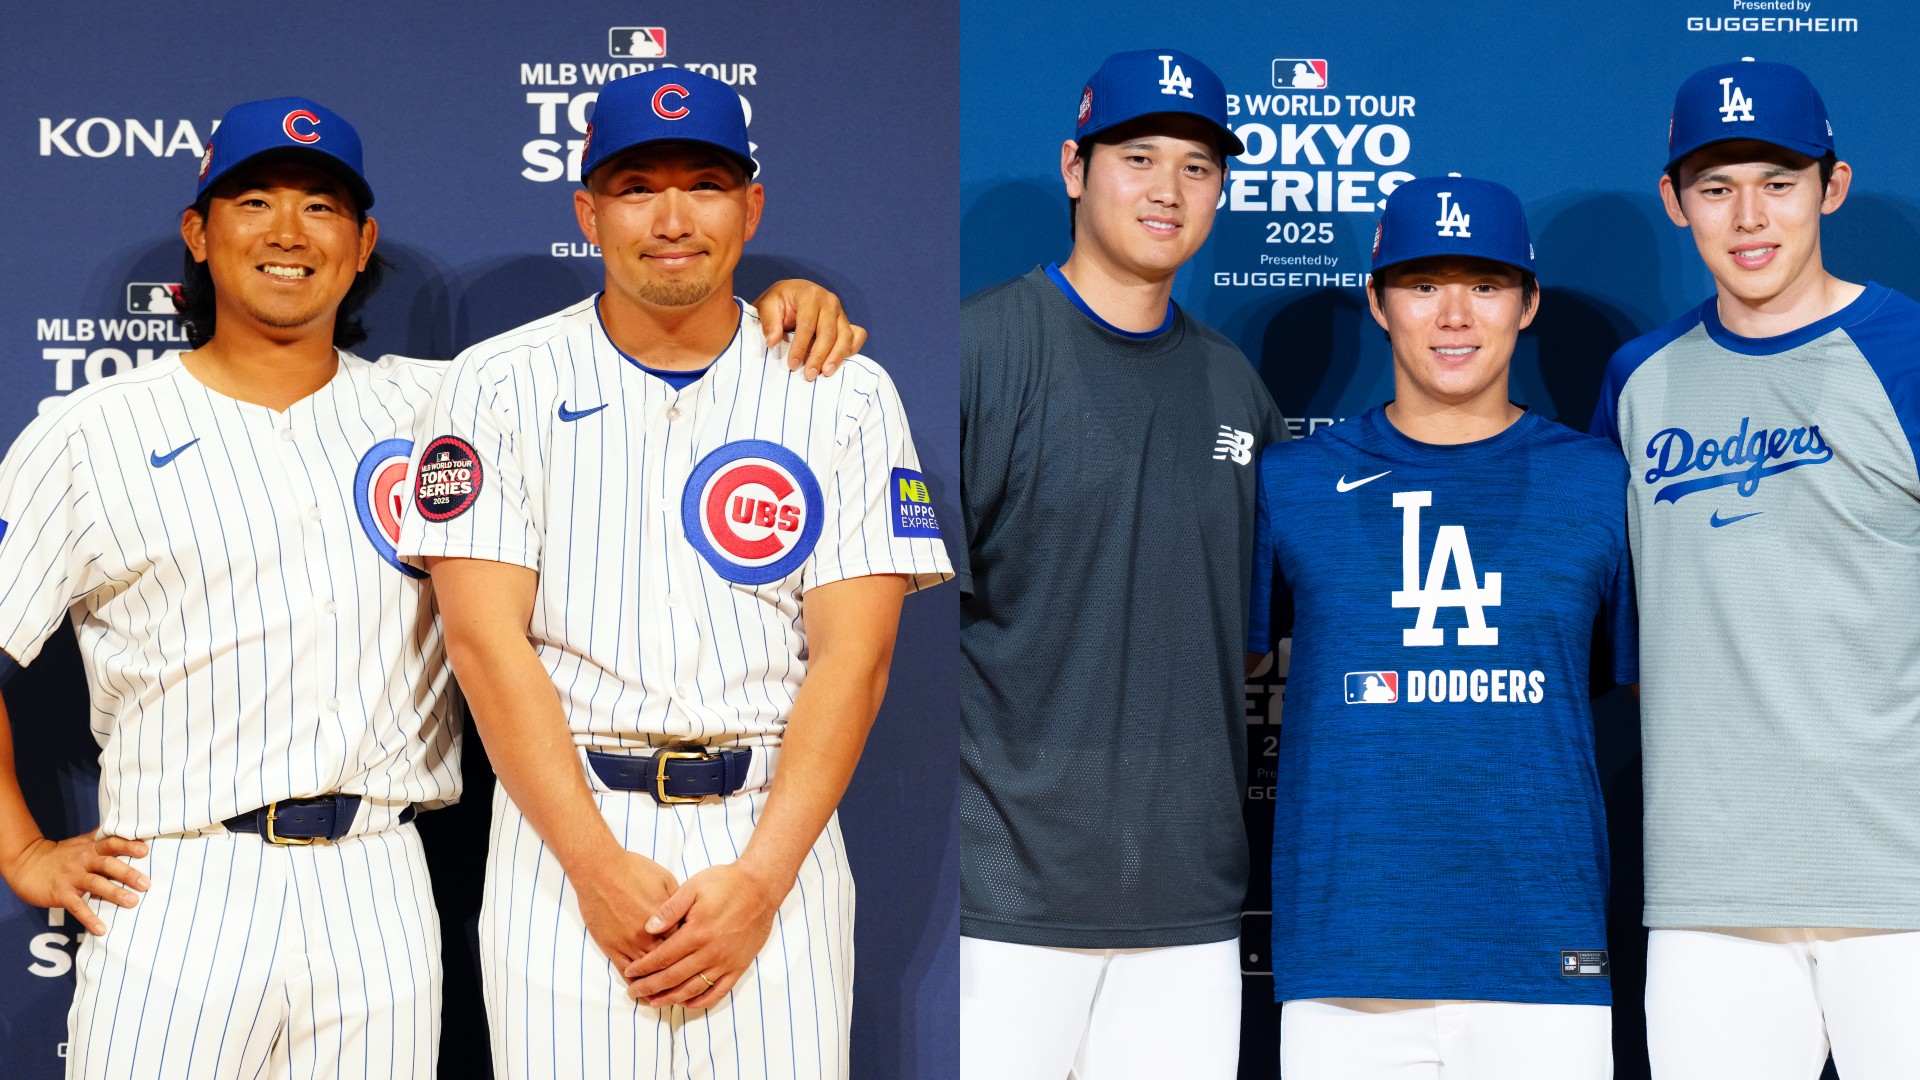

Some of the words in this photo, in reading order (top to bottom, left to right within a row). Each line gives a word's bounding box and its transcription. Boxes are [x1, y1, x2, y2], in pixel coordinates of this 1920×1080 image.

[1733, 0, 1795, 10] Presented
[1796, 0, 1811, 12] by
[1687, 17, 1858, 32] GUGGENHEIM
[520, 63, 577, 85] MLB
[1158, 55, 1194, 99] LA
[651, 83, 691, 121] C
[1245, 94, 1341, 116] WORLD
[1345, 95, 1416, 117] TOUR
[1719, 77, 1755, 123] LA
[38, 117, 222, 158] KONA
[282, 109, 321, 144] C
[1227, 122, 1411, 166] OKYO
[1435, 191, 1472, 238] LA
[1265, 221, 1335, 244] 2025
[1260, 254, 1322, 265] Presented
[1324, 255, 1339, 267] by
[37, 318, 95, 341] MLB
[99, 319, 188, 342] WORL
[431, 461, 453, 471] WORLD
[453, 460, 473, 468] TOUR
[1645, 416, 1834, 504] Dodgers
[421, 468, 471, 486] TOKYO
[419, 481, 472, 499] SERIES
[433, 497, 450, 505] 2025
[900, 504, 935, 518] NIPPO
[902, 516, 940, 530] EXPRES
[1391, 490, 1502, 647] LA
[1407, 669, 1545, 704] DODGERS
